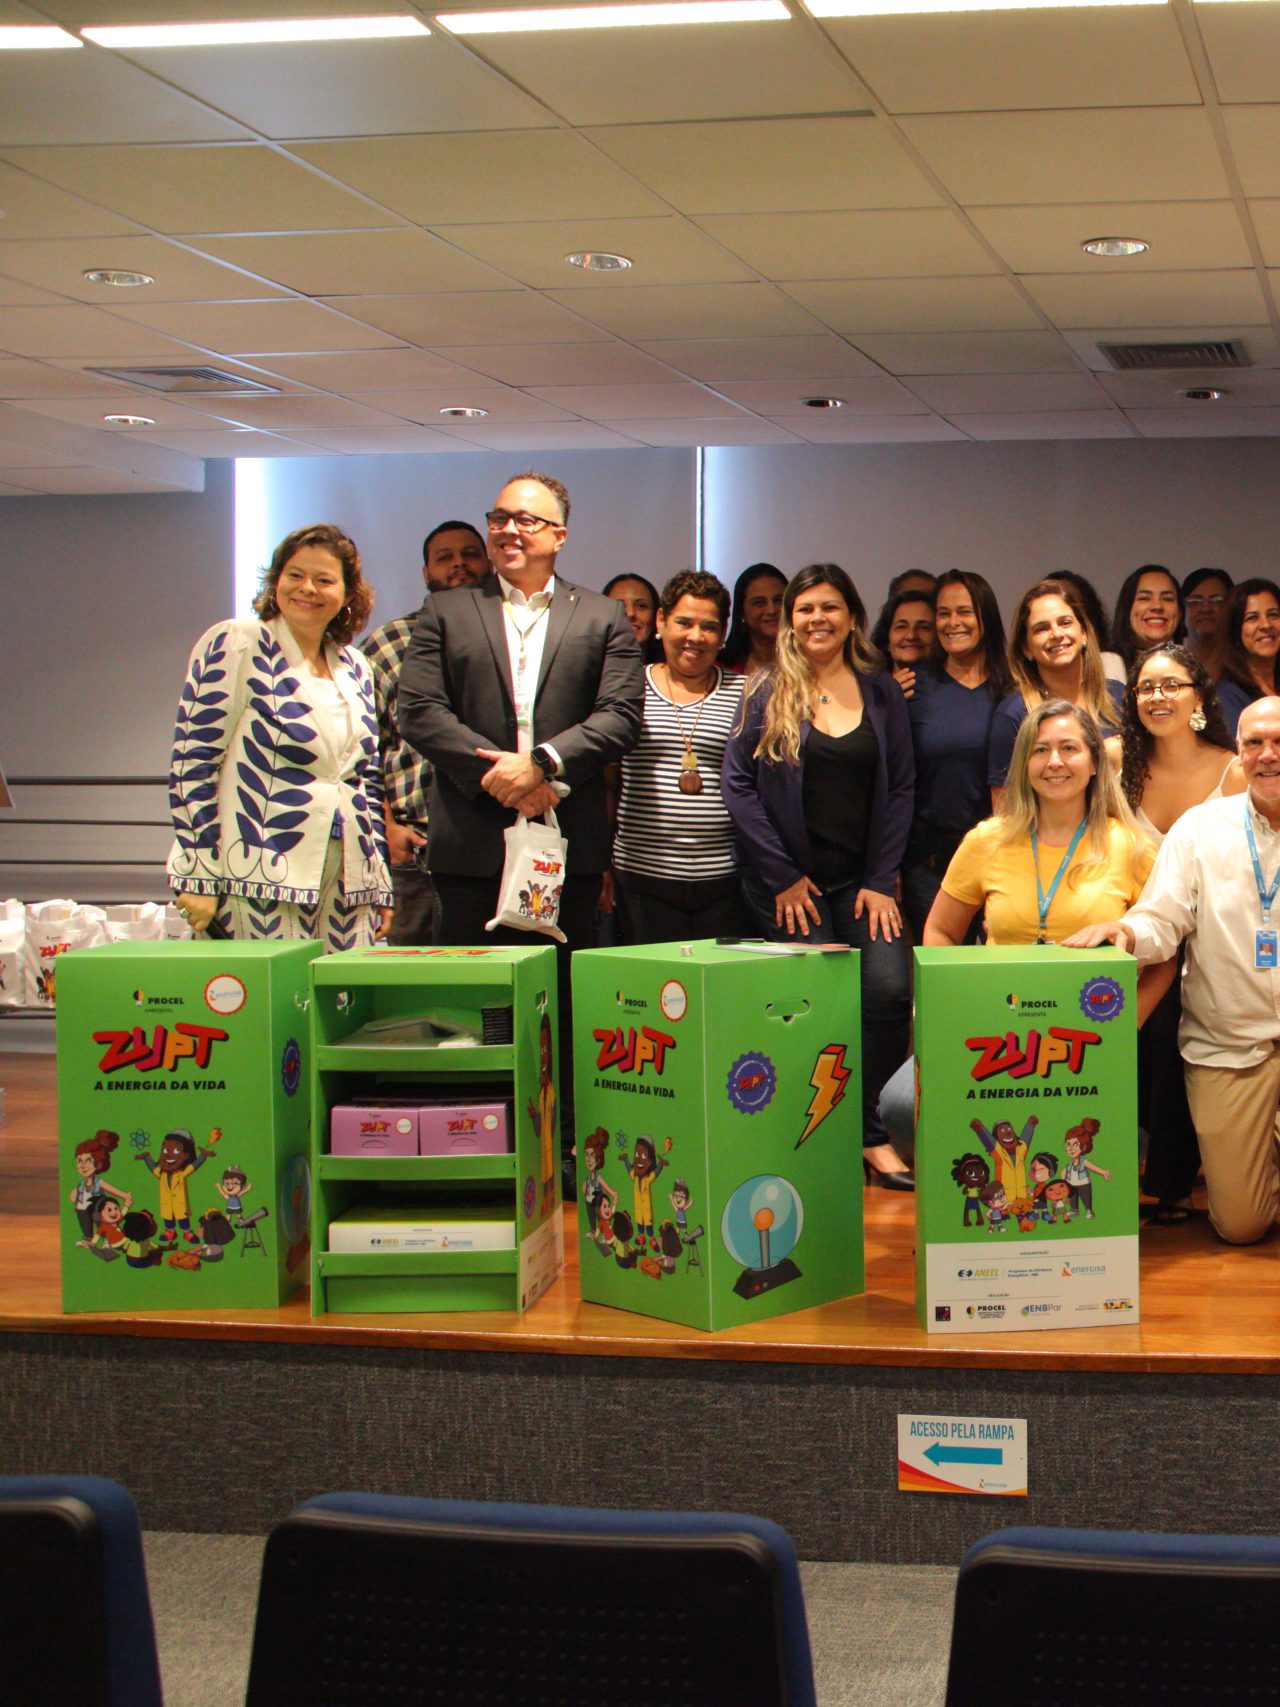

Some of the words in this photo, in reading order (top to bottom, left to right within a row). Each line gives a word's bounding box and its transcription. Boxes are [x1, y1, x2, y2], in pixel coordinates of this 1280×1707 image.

[147, 997, 184, 1005] PROCEL
[625, 998, 647, 1009] PROCEL
[1021, 1000, 1058, 1009] PROCEL
[92, 1022, 230, 1074] ZUPT
[592, 1025, 677, 1075] ZUPT
[965, 1026, 1102, 1082] ZUPT
[94, 1081, 103, 1090] A
[107, 1081, 167, 1090] ENERGIA
[170, 1081, 189, 1090] DA
[193, 1080, 226, 1090] VIDA
[594, 1078, 600, 1088] A
[601, 1079, 637, 1093] ENERGIA
[639, 1083, 651, 1095] DA
[653, 1086, 675, 1098] VIDA
[966, 1089, 976, 1099] A
[979, 1088, 1040, 1099] ENERGIA
[1043, 1087, 1063, 1097] DA
[1066, 1085, 1098, 1097] VIDA
[974, 1268, 1000, 1277] ANEEL
[911, 1421, 948, 1437] ACESSO
[951, 1423, 976, 1439] PELA
[979, 1424, 1014, 1440] RAMPA
